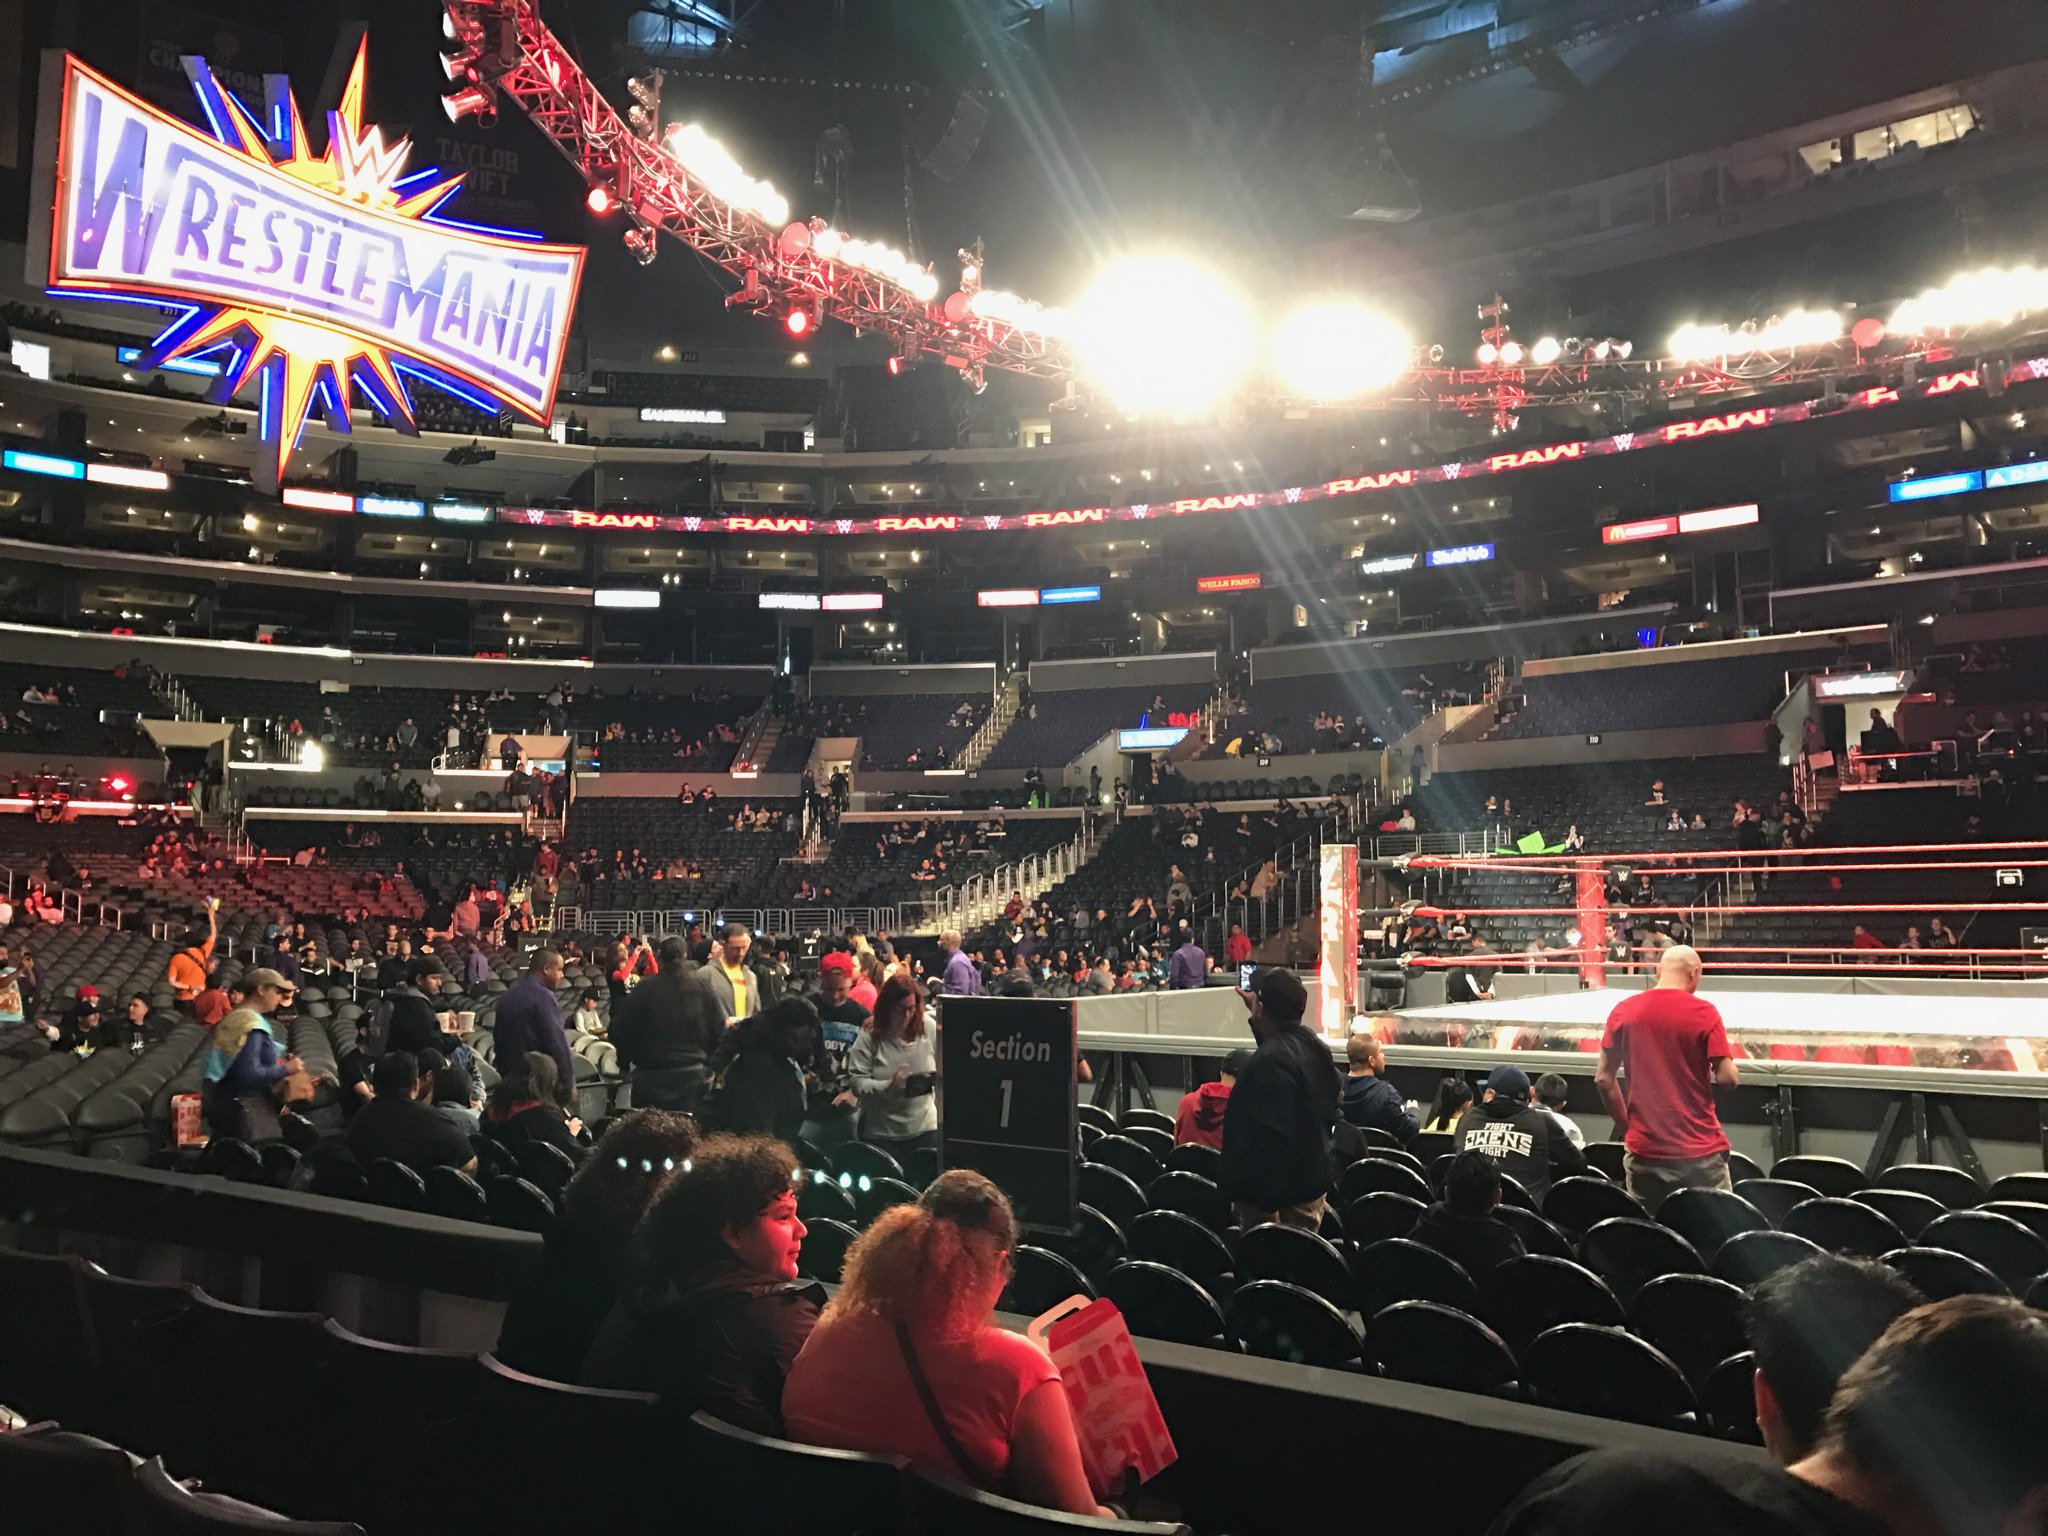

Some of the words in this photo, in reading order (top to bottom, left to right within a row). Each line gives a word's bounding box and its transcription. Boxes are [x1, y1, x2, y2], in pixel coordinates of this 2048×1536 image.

[573, 509, 655, 528] RAW
[728, 517, 807, 532] RAW
[878, 516, 956, 531] RAW
[1027, 508, 1103, 527] RAW
[1175, 493, 1256, 514] RAW
[1328, 470, 1412, 495] RAW
[1490, 442, 1580, 471] RAW
[1666, 408, 1768, 441] RAW
[1199, 580, 1229, 589] WELLS
[1230, 577, 1260, 586] FARGO
[970, 1030, 1051, 1062] Section
[1000, 1079, 1013, 1128] 1
[1484, 1122, 1515, 1131] FIGHT
[1465, 1131, 1532, 1155] OWENS
